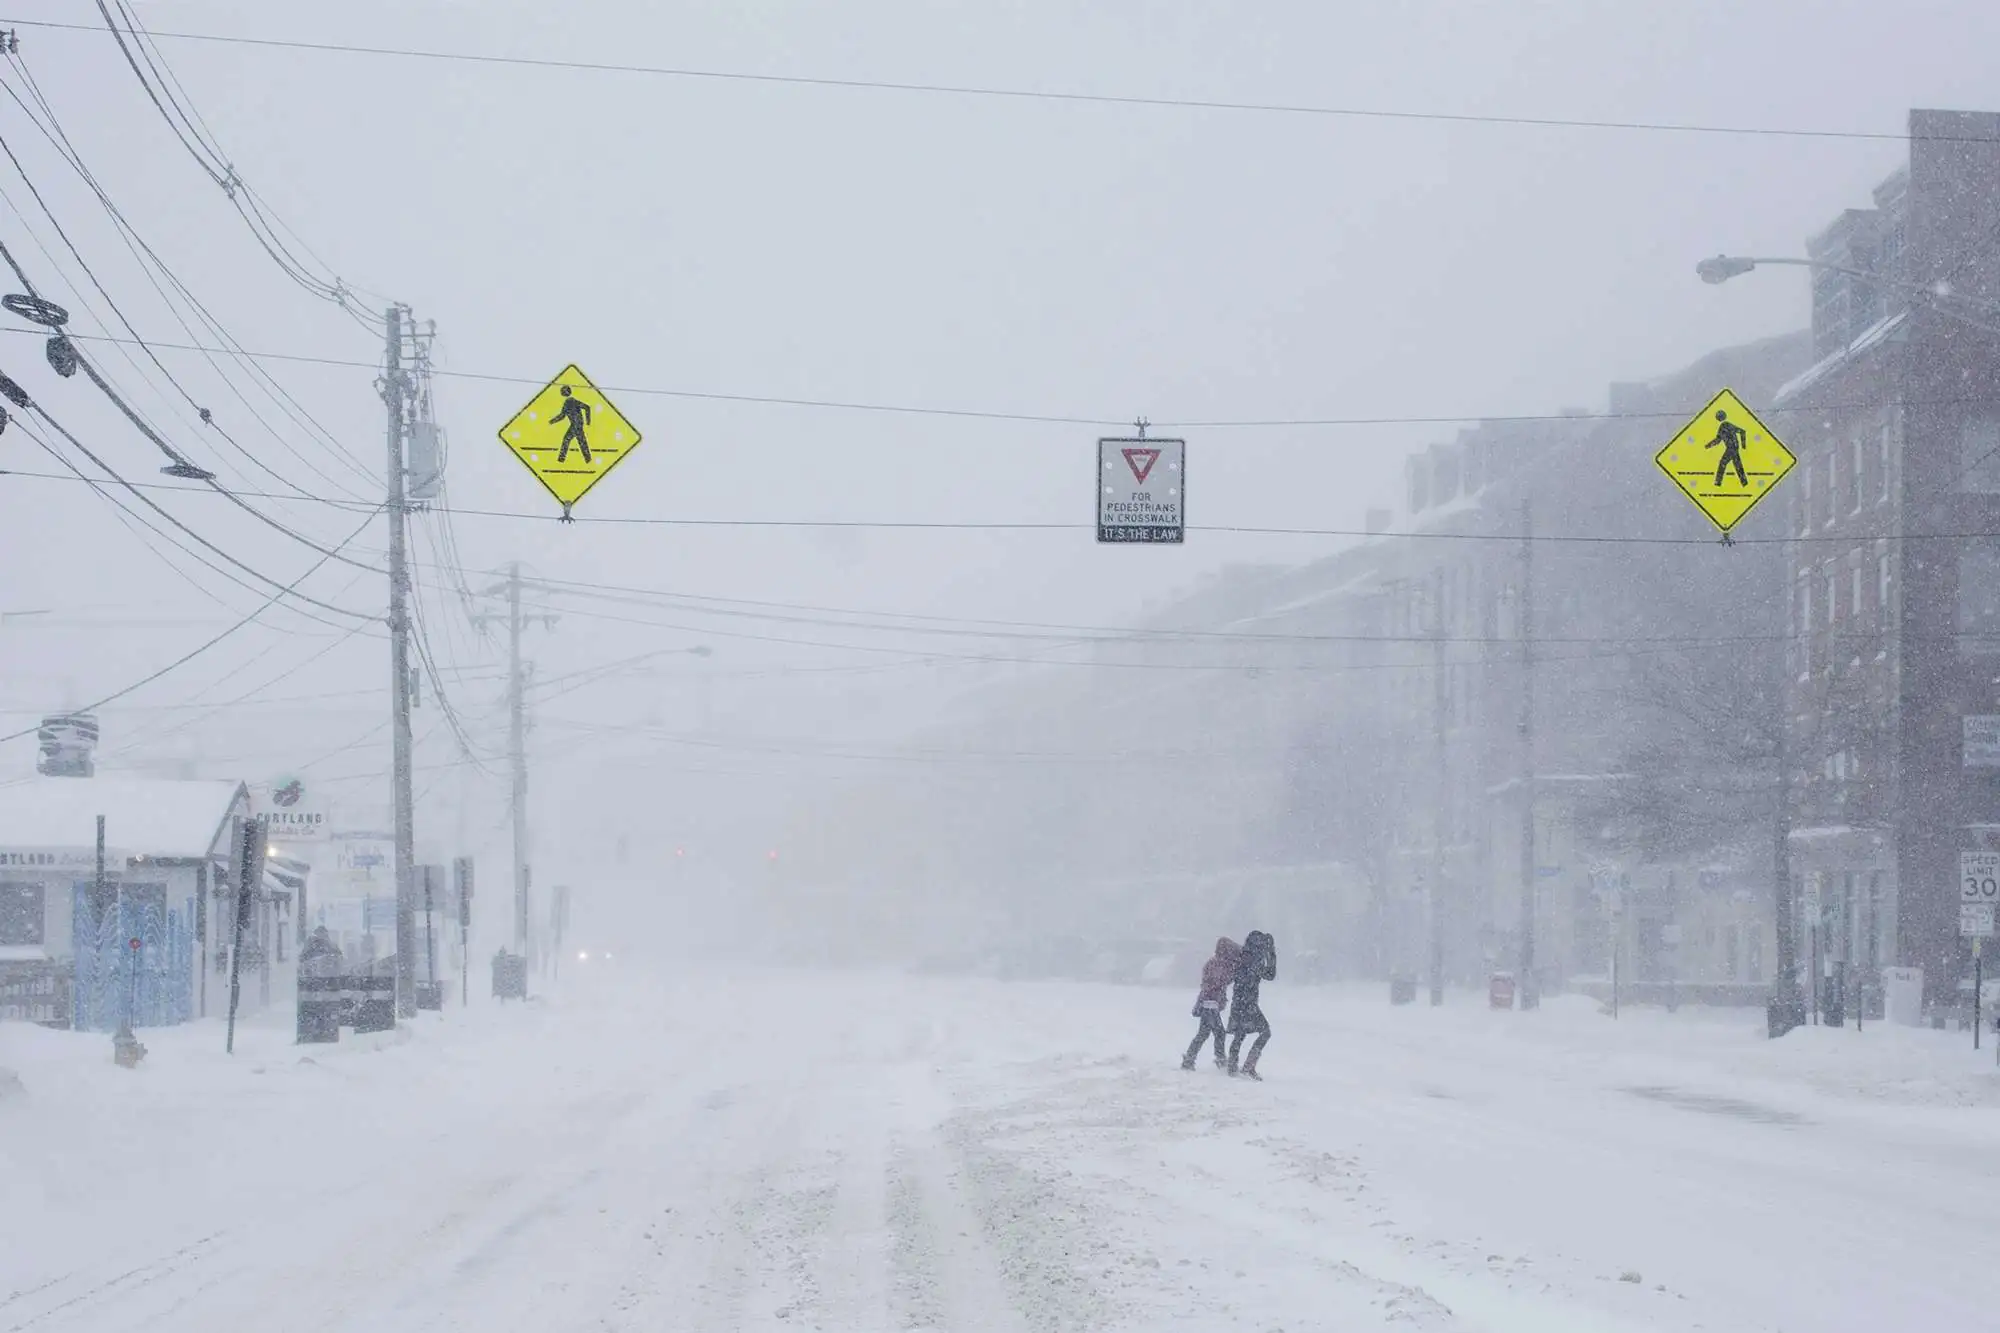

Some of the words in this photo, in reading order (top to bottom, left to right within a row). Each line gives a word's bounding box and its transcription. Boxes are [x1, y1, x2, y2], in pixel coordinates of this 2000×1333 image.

[1132, 492, 1151, 501] FOR
[1107, 502, 1176, 512] PEDESTRIANS
[1104, 513, 1114, 522] IN
[1118, 513, 1178, 523] CROSSWALK
[1130, 529, 1149, 539] THE
[1153, 529, 1177, 539] LAW
[1963, 855, 1998, 864] SPEED
[1967, 867, 1993, 875] LIMIT
[1965, 877, 1997, 896] 30
